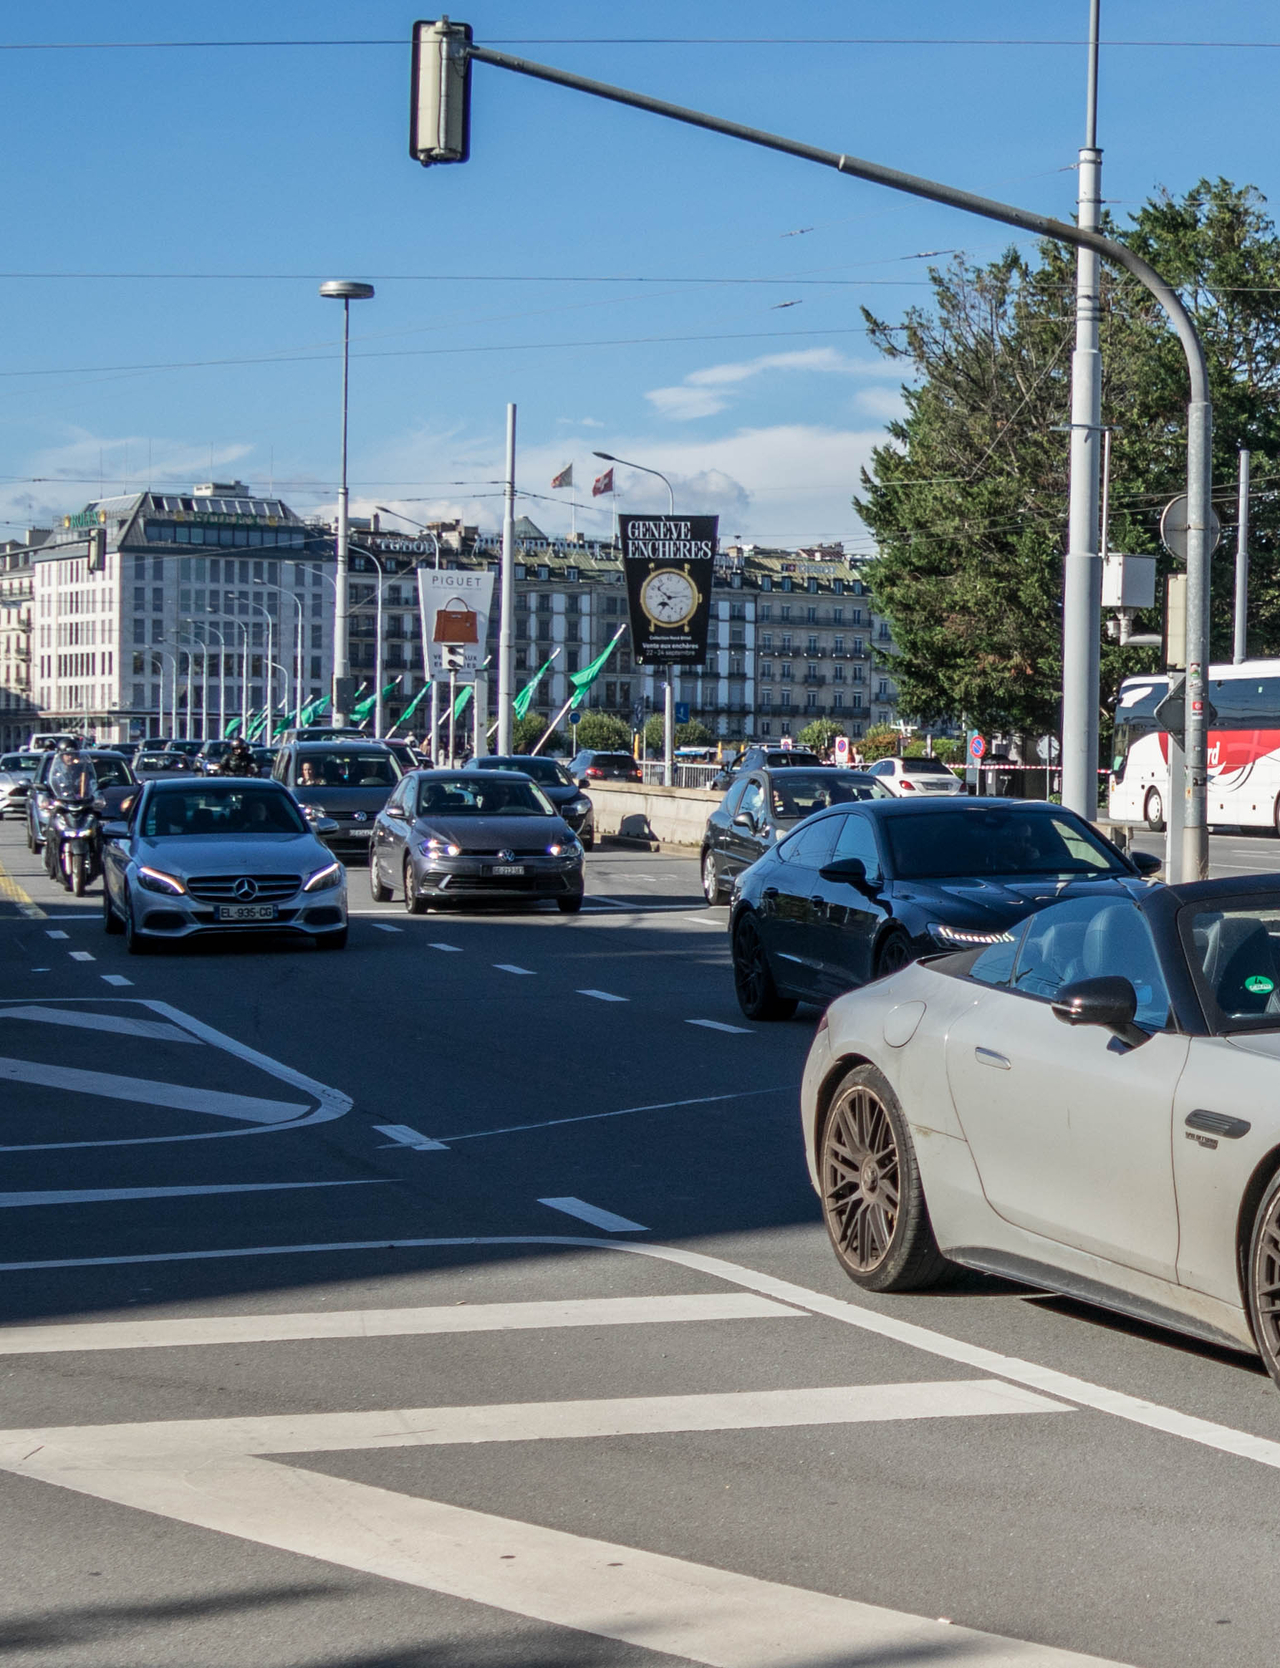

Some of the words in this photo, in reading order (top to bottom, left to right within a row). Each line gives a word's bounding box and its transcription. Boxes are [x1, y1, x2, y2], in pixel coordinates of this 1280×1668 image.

[627, 516, 691, 540] GENÈVE
[627, 538, 712, 559] ENCHÈRES
[432, 575, 482, 587] PIGUET
